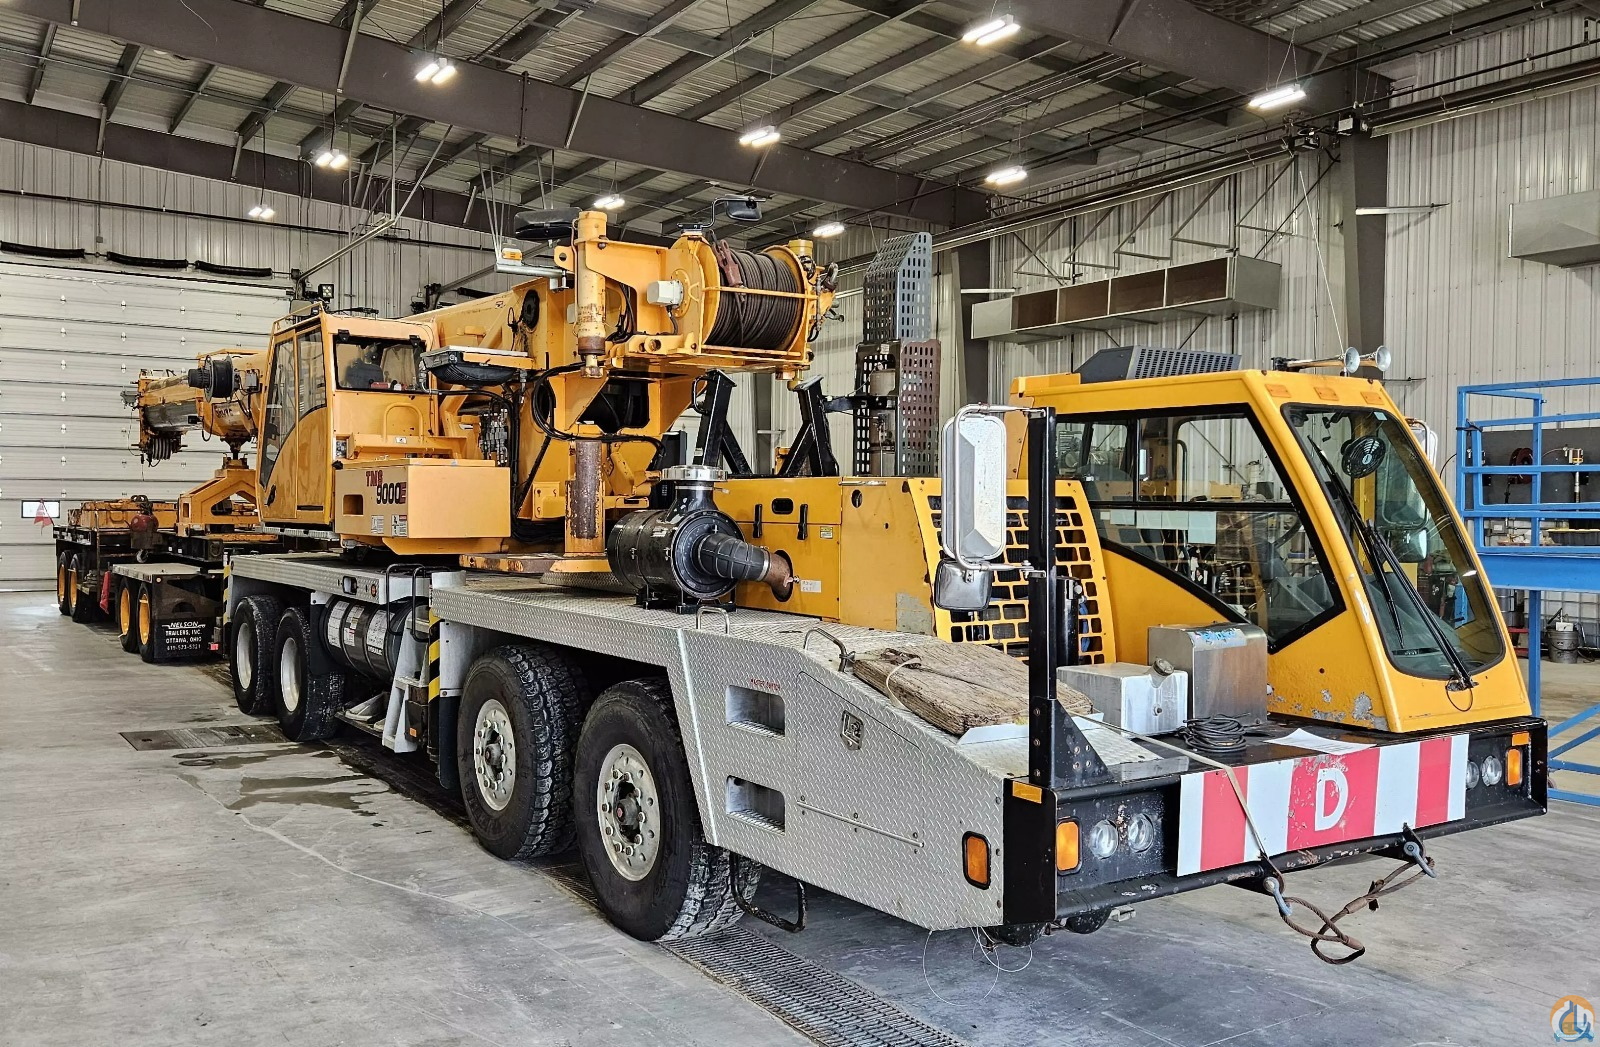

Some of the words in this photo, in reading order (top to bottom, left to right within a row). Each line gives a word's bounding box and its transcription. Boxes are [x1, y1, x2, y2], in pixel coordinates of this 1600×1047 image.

[366, 470, 383, 487] TMS
[376, 482, 407, 505] 9000E
[1314, 767, 1349, 831] D
